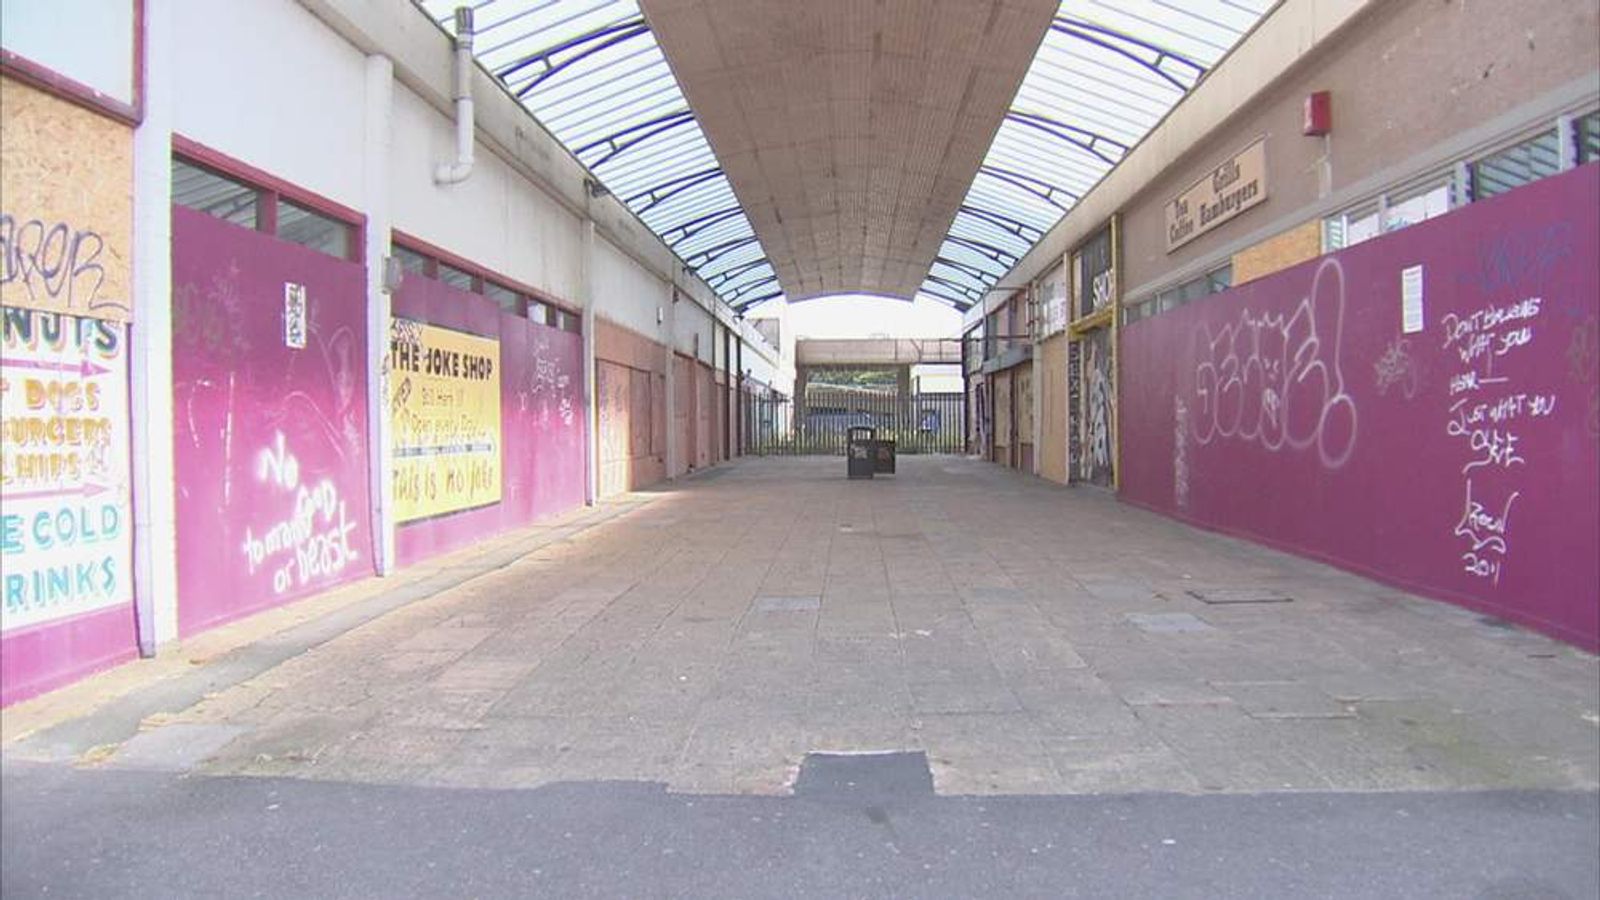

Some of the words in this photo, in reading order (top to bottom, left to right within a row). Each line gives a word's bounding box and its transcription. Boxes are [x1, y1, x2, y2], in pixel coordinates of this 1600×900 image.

[391, 341, 420, 372] THE
[425, 348, 460, 378] JOKE
[461, 353, 493, 381] SHOP
[32, 503, 122, 549] COLD
